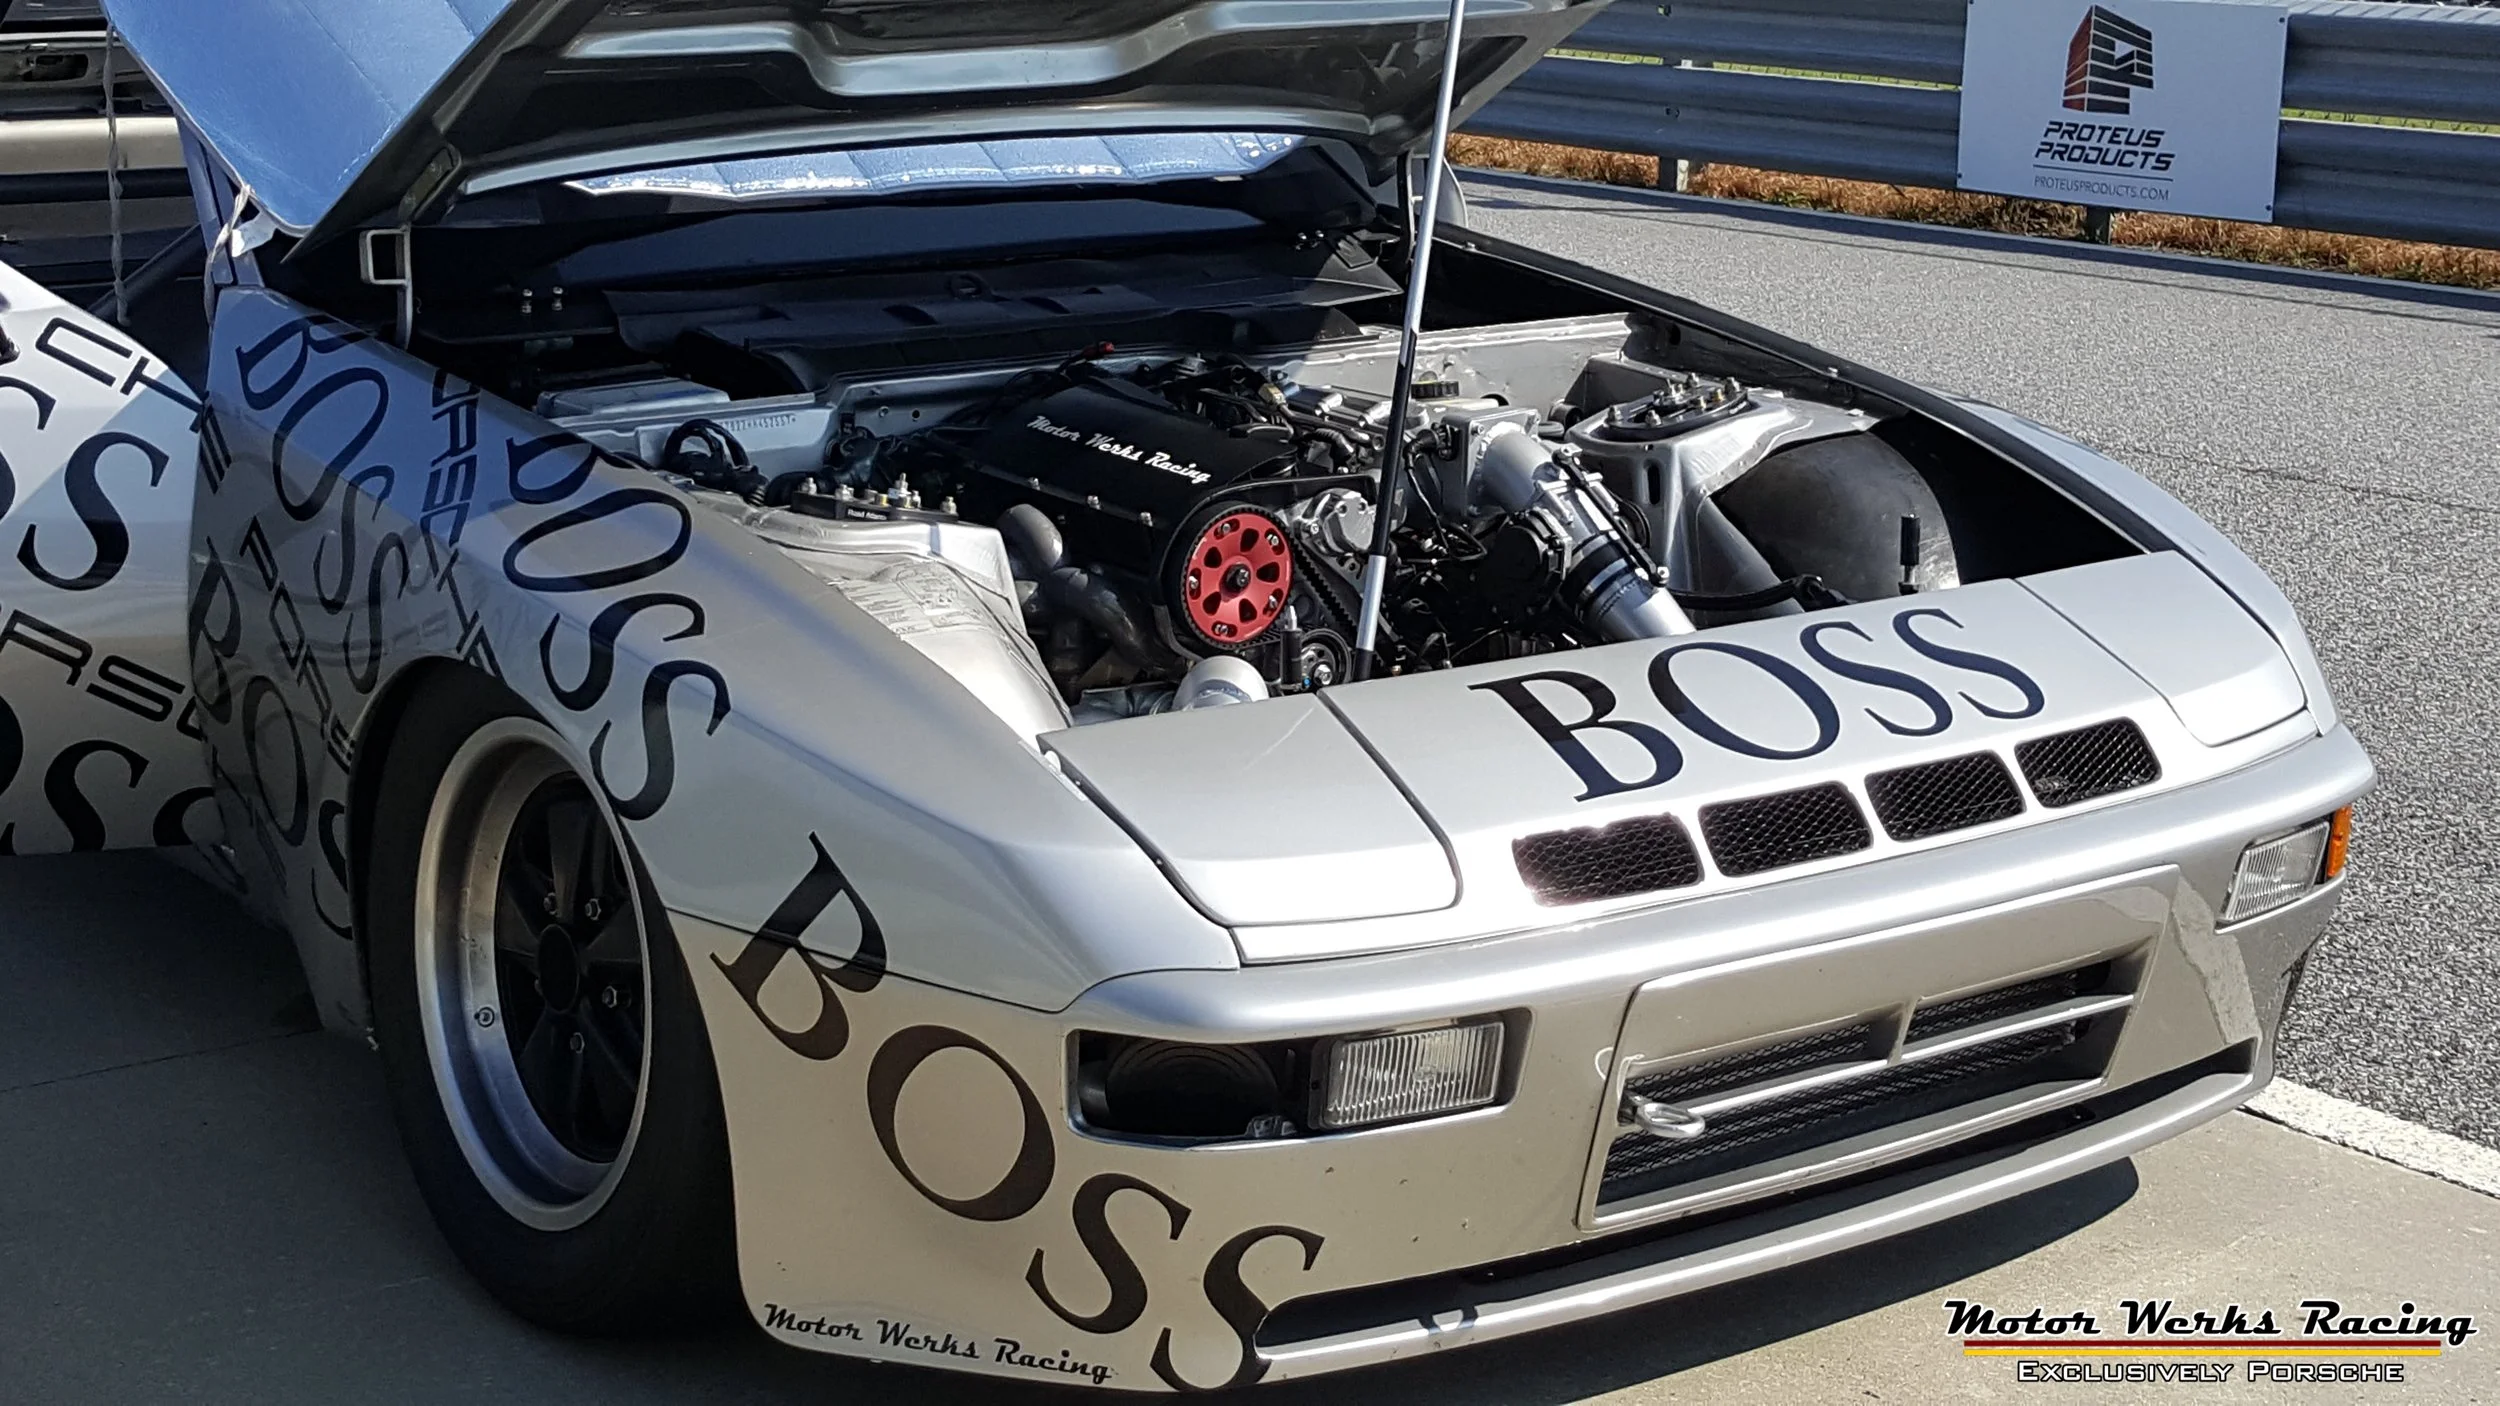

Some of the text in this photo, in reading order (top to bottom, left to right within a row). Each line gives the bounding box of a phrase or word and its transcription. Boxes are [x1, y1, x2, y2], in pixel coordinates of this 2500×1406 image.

[2034, 141, 2176, 172] PRODUCTS
[2043, 120, 2166, 148] PROTEUS
[2034, 175, 2169, 201] PROTEUSPRODUCTS.COM
[1027, 415, 1212, 485] Motor Werks Racing
[236, 315, 410, 695] BOSS
[503, 432, 731, 821] BOSS
[1467, 608, 2046, 803] BOSS
[709, 830, 1325, 1392] BOSS
[764, 1302, 1113, 1385] Motor Werks Racing
